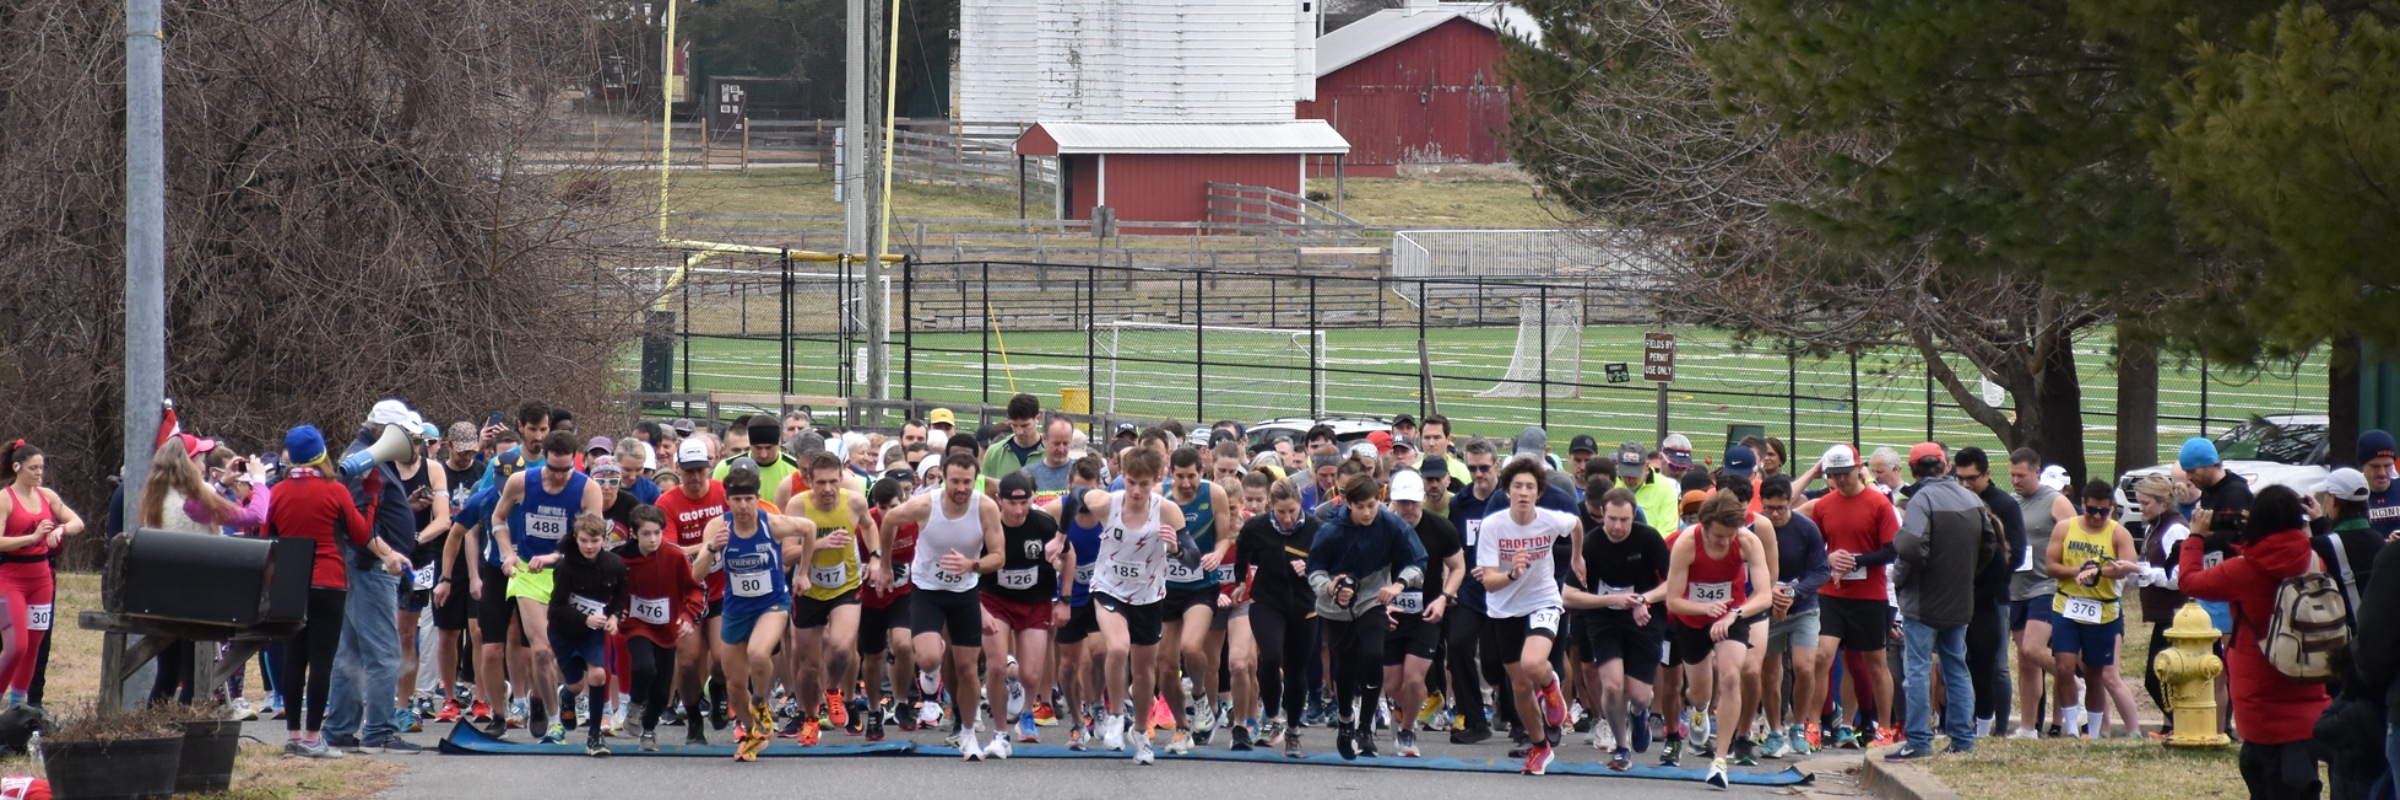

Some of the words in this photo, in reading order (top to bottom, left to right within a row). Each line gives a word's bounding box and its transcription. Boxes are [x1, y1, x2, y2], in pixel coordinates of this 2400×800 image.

[1646, 340, 1665, 349] FIELDS
[1666, 341, 1674, 349] BY
[1649, 353, 1669, 362] PERMIT
[1646, 365, 1656, 374] USE
[1657, 365, 1672, 375] ONLY
[679, 505, 724, 521] CROFTON
[532, 521, 560, 533] 488
[1499, 536, 1551, 549] CROFTON
[816, 570, 841, 583] 417
[935, 570, 962, 583] 455
[1112, 565, 1139, 578] 185
[742, 579, 760, 591] 80
[1005, 574, 1032, 585] 126
[1697, 587, 1725, 600] 345
[637, 603, 663, 618] 476
[2071, 602, 2097, 617] 376
[33, 611, 51, 624] 30
